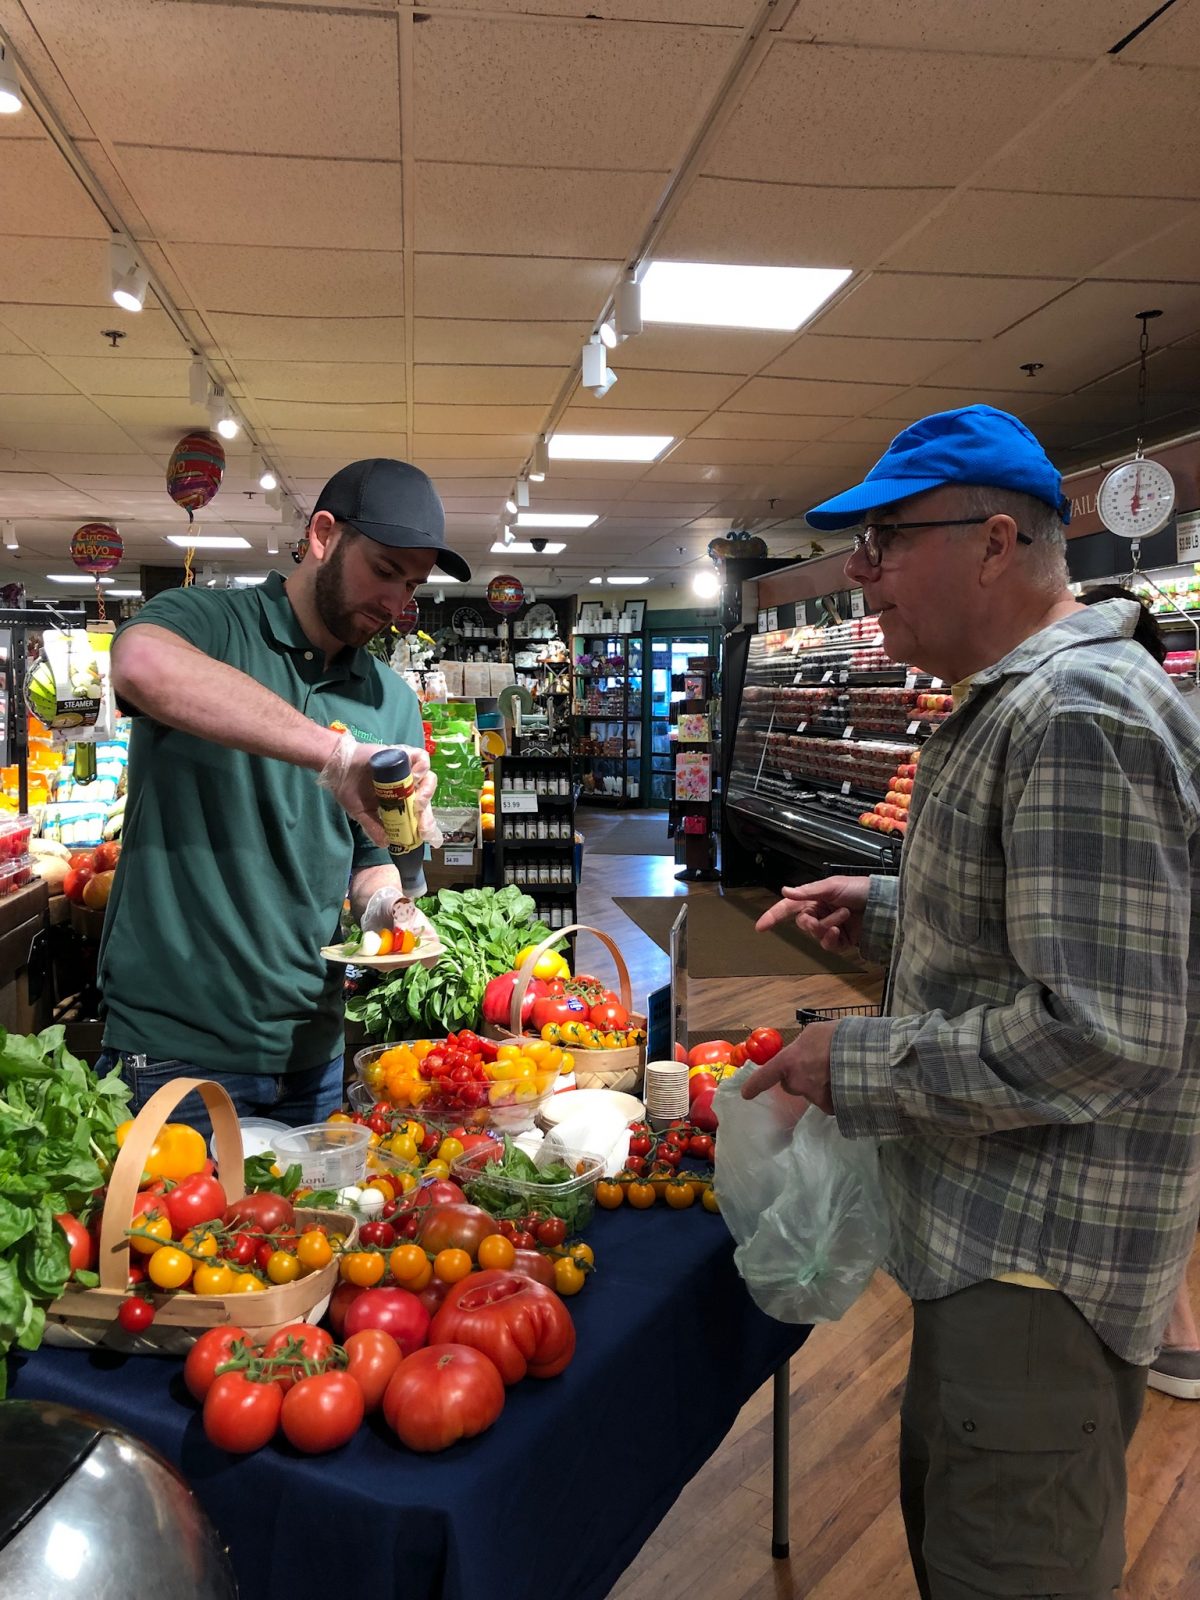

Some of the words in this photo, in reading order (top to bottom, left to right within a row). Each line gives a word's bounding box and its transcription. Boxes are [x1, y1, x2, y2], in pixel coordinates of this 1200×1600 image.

[76, 531, 109, 542] Cinco
[74, 542, 110, 557] Mayo
[64, 701, 94, 709] STEAMER
